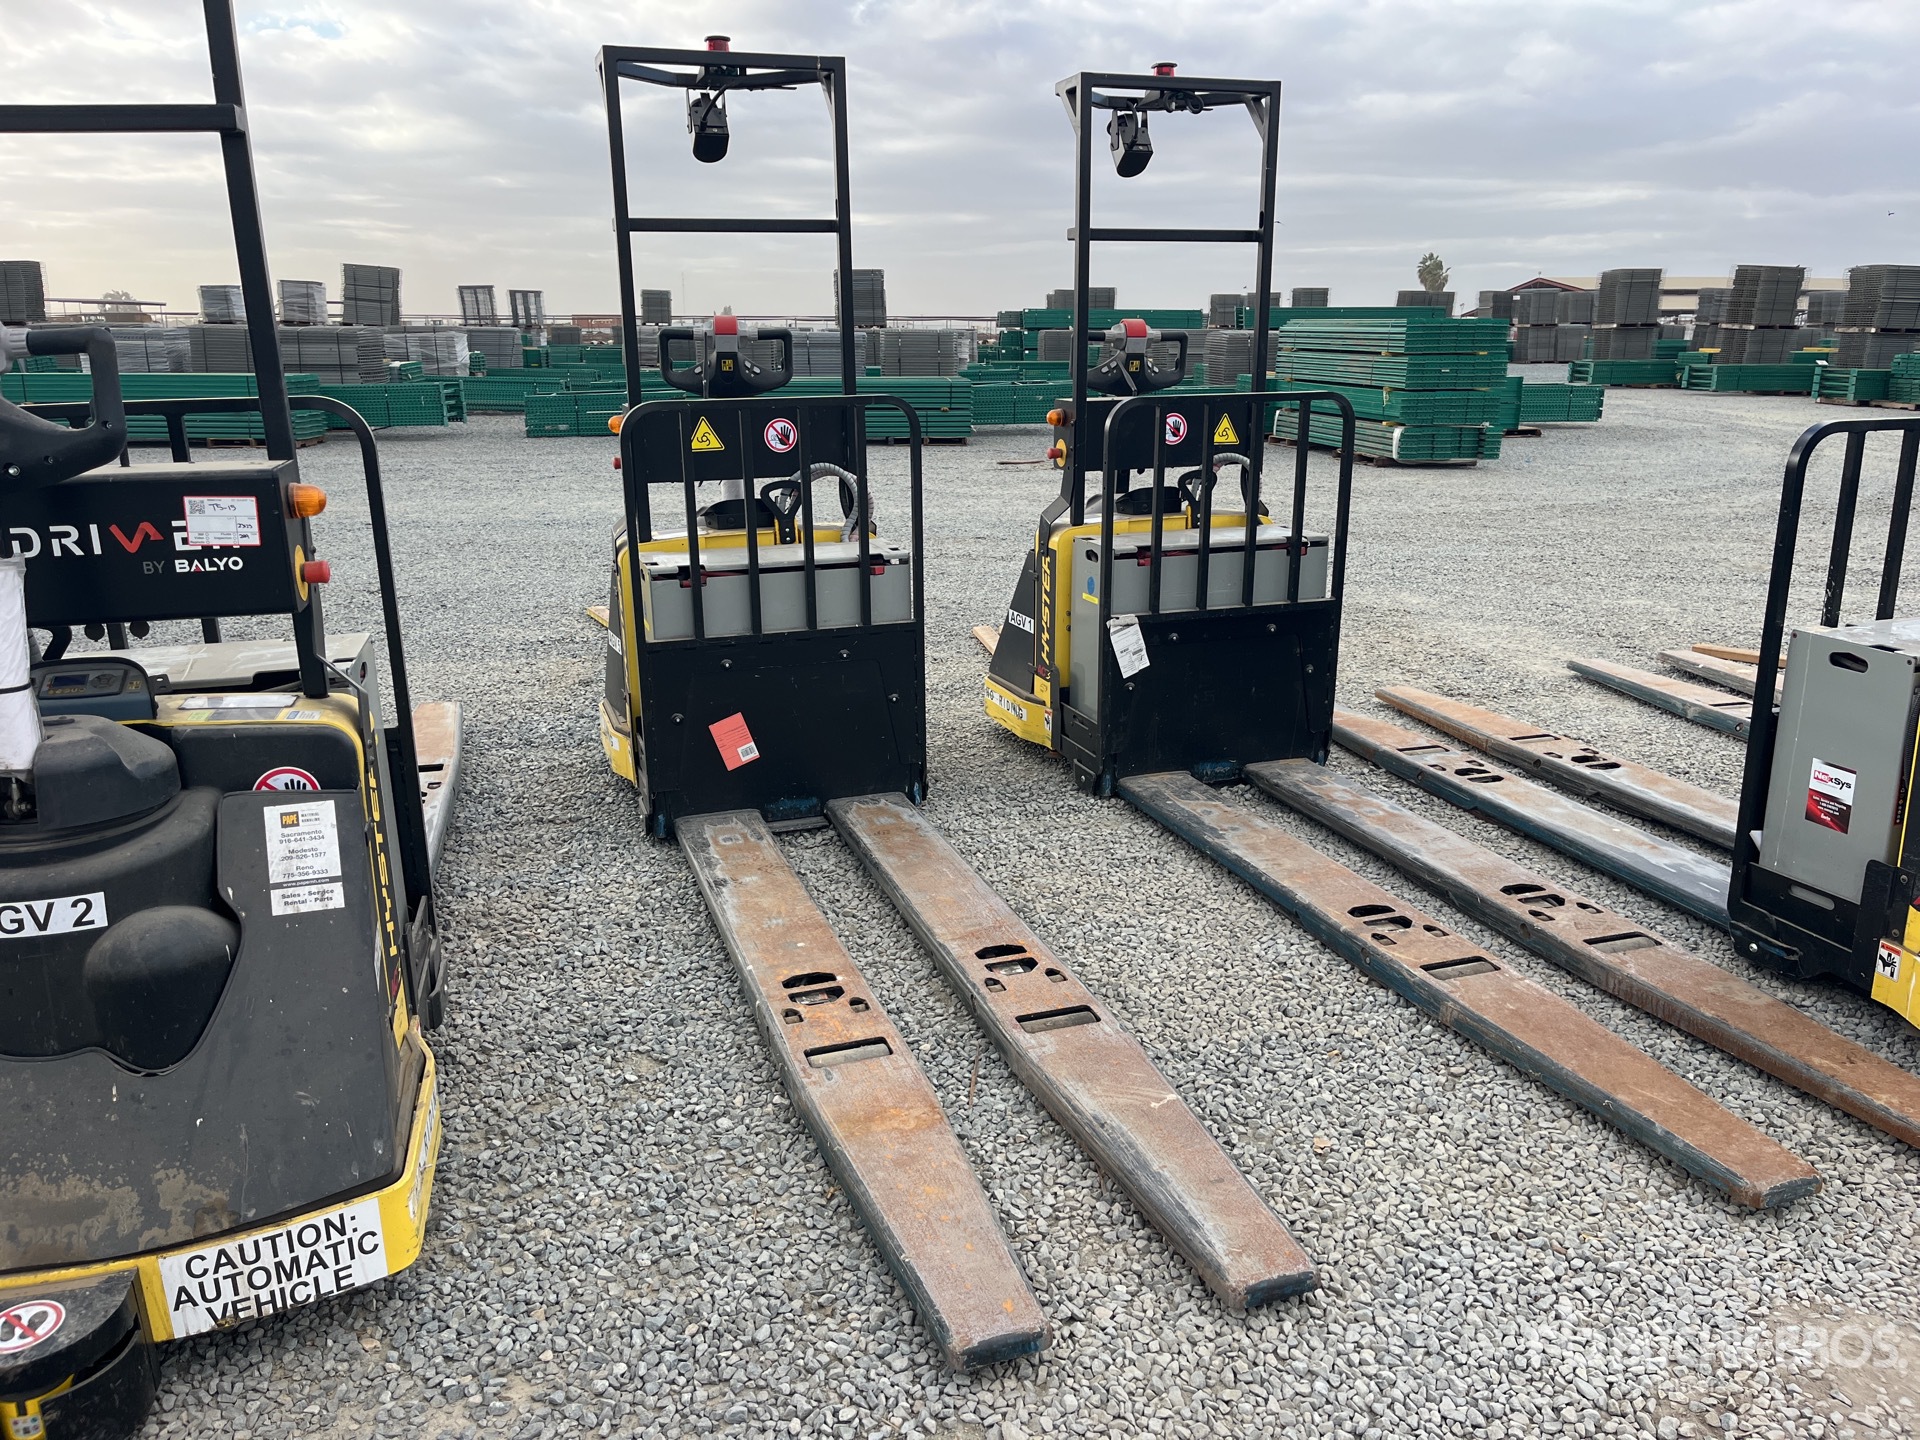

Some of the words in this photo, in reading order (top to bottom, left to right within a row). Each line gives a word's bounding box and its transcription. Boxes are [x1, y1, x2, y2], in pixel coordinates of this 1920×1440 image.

[143, 561, 165, 575] BY
[174, 556, 243, 573] BALYO
[1010, 611, 1027, 629] AGV
[1028, 618, 1033, 632] 1
[1813, 770, 1852, 790] NexSys
[282, 814, 298, 825] PAPE
[280, 829, 322, 839] Sacramento
[288, 846, 319, 854] Modesto
[295, 864, 314, 873] Reno
[281, 892, 302, 901] Sales
[284, 898, 308, 907] Rental
[314, 895, 334, 904] Parts
[70, 897, 95, 928] 2
[185, 1212, 359, 1279] CAUTION:
[173, 1230, 380, 1312] AUTOMATIC
[205, 1264, 356, 1328] VEHICLE
